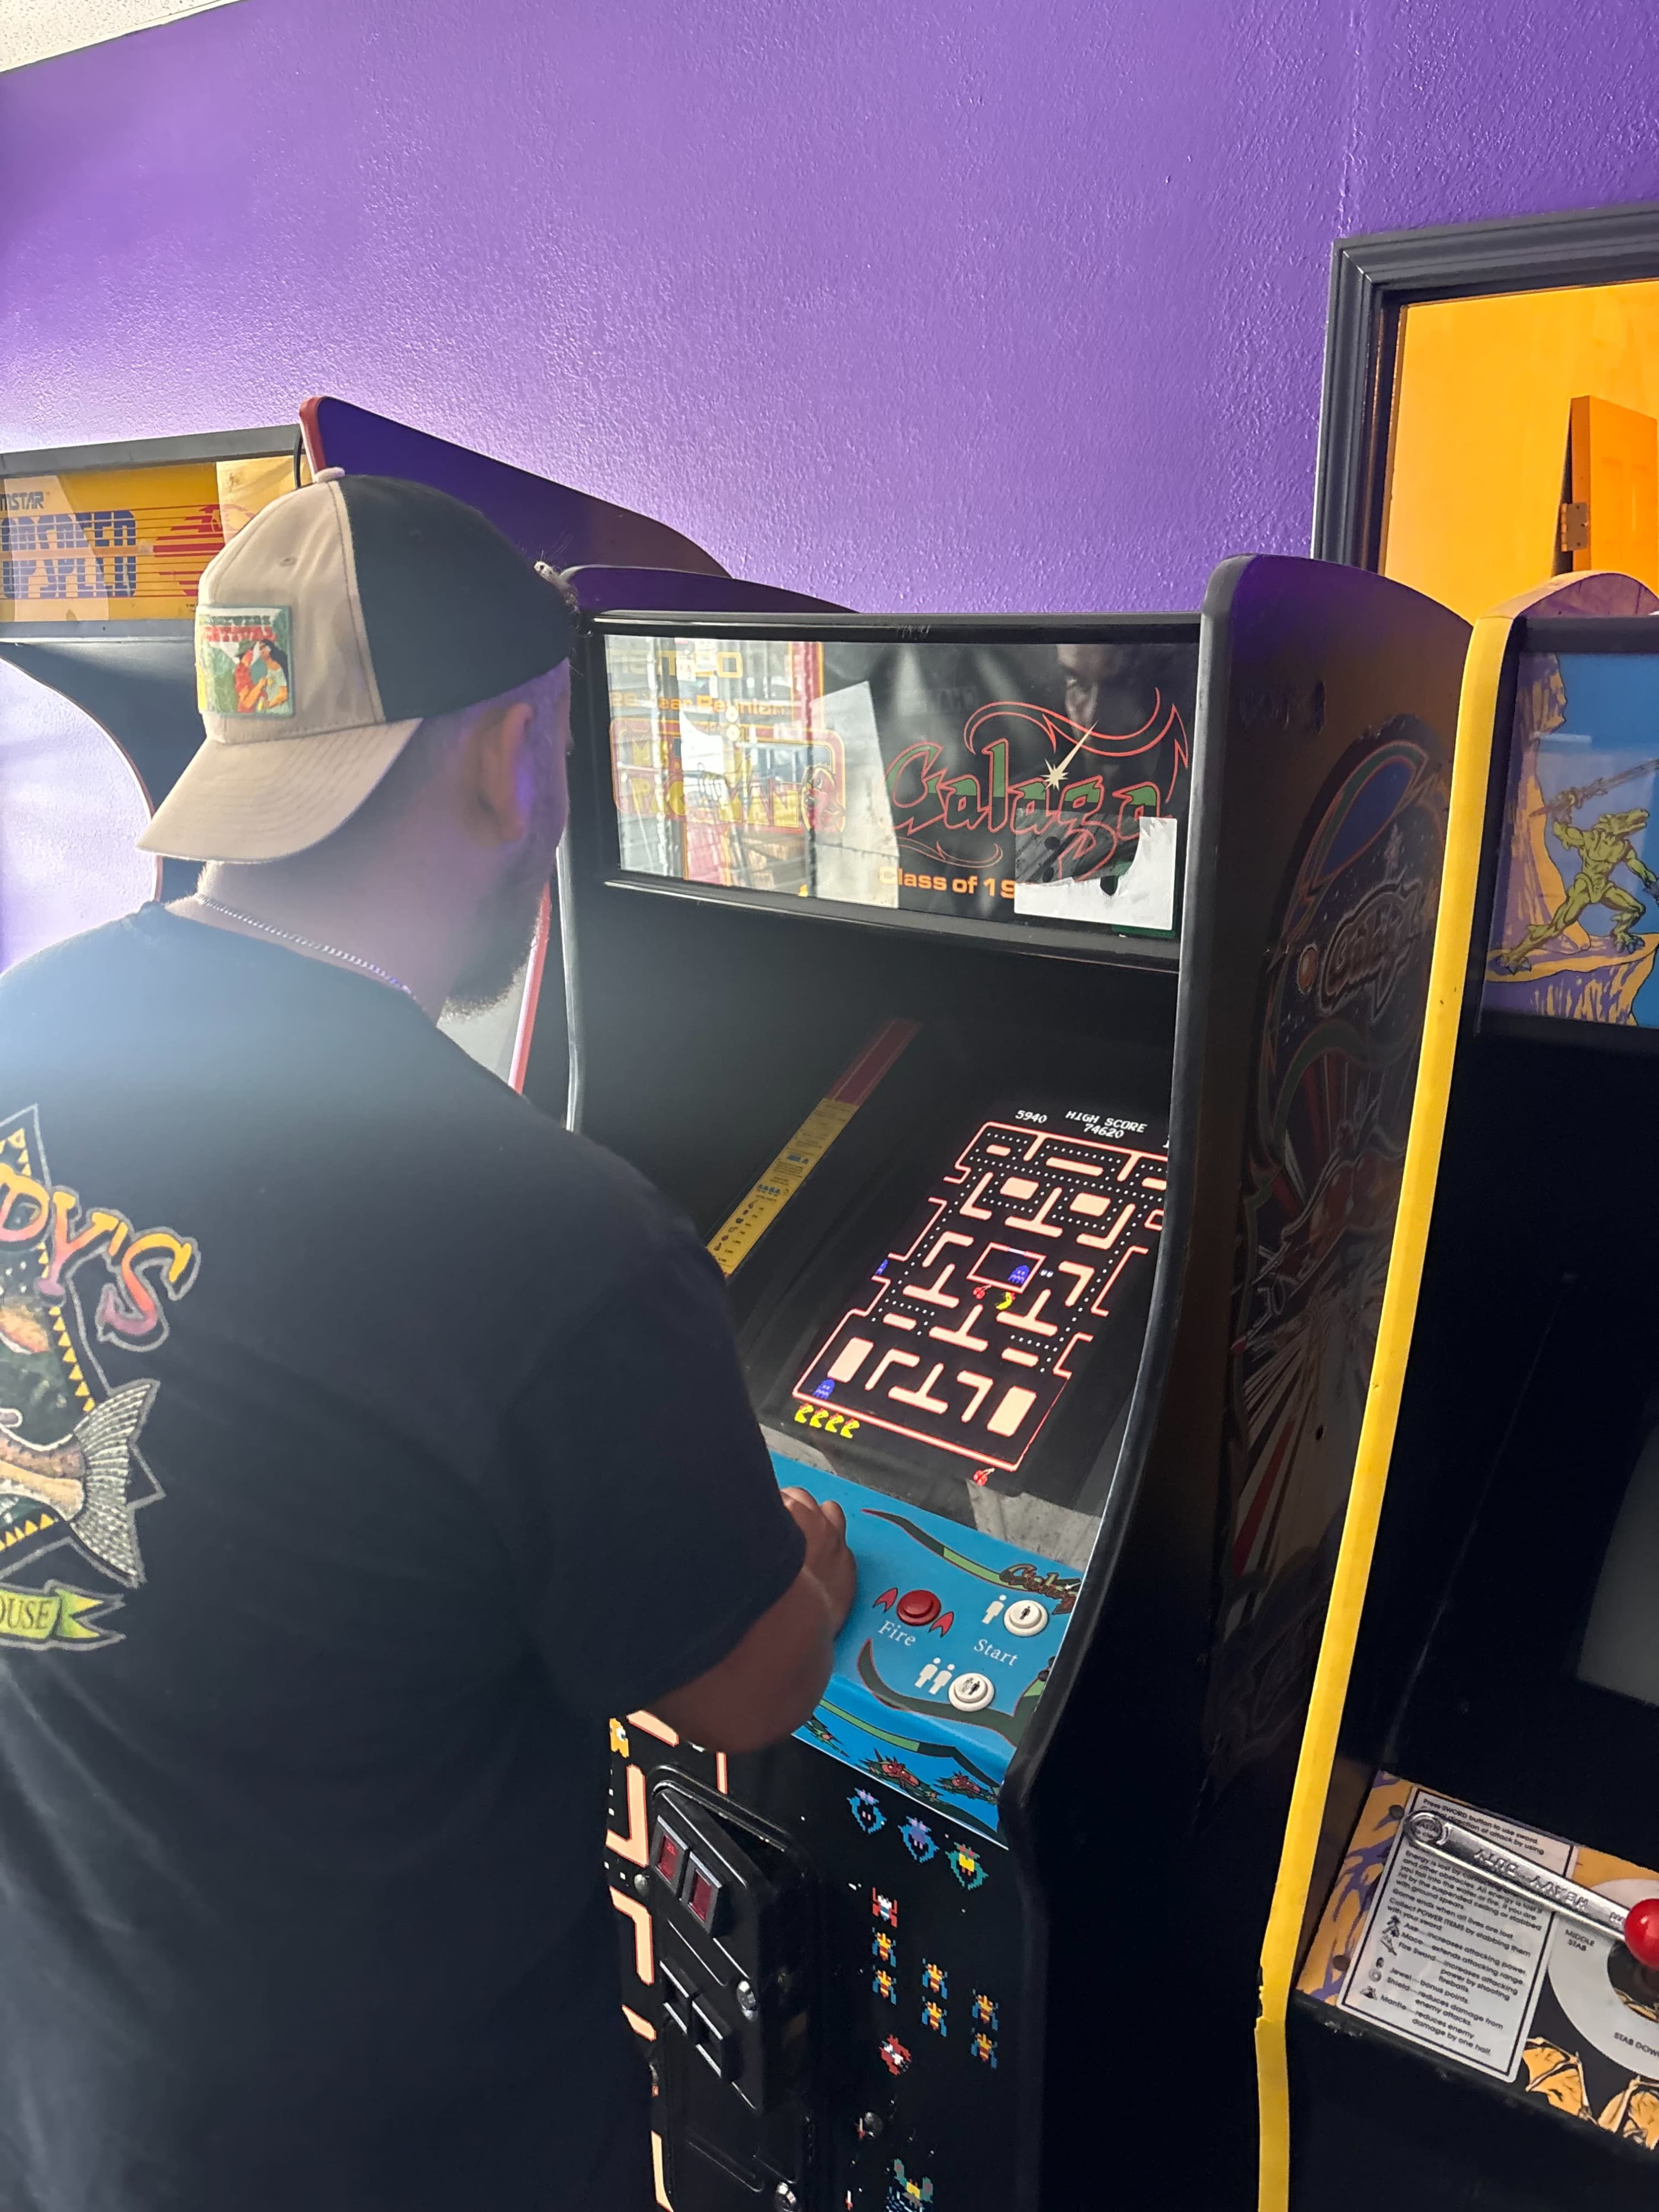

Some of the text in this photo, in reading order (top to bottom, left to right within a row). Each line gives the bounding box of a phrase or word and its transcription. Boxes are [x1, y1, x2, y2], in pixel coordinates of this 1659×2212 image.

[879, 865, 1015, 899] Class of 19
[1015, 1109, 1147, 1133] 5940 HIGH SCORE
[1083, 1123, 1124, 1138] 74620
[877, 1620, 916, 1646] Fire
[974, 1638, 1018, 1666] Start
[1423, 1798, 1440, 1809] Press
[1442, 1805, 1467, 1818] SWORD
[1468, 1815, 1492, 1827] button
[1489, 1831, 1512, 1843] attack
[1524, 1844, 1544, 1855] using
[1405, 1850, 1429, 1863] Energy
[1452, 1867, 1461, 1875] by
[1396, 1880, 1410, 1889] with
[1411, 1886, 1438, 1899] ground
[1400, 1865, 1414, 1873] you
[1414, 1870, 1426, 1878] fall
[1427, 1875, 1441, 1884] into
[1443, 1881, 1454, 1889] the
[1456, 1887, 1476, 1897] water
[1508, 1907, 1522, 1915] you
[1403, 1858, 1418, 1867] and
[1418, 1864, 1438, 1874] other
[1488, 1891, 1514, 1904] energy
[1523, 1902, 1537, 1911] lost
[1387, 1905, 1402, 1915] with
[1403, 1912, 1418, 1921] your
[1392, 1888, 1415, 1901] Game
[1416, 1898, 1434, 1908] ends
[1436, 1905, 1455, 1916] when
[1468, 1917, 1484, 1928] lives
[1485, 1925, 1498, 1933] are
[1408, 1875, 1417, 1884] by
[1418, 1879, 1430, 1888] the
[1432, 1885, 1472, 1904] suspended
[1474, 1902, 1499, 1916] ceiling
[1509, 1915, 1541, 1931] stabbed
[1389, 1897, 1416, 1911] Collect
[1417, 1908, 1443, 1922] POWER
[1444, 1919, 1464, 1931] ITEMS
[1476, 1932, 1510, 1950] stabbing
[1511, 1945, 1530, 1957] them
[1564, 1929, 1595, 1947] MIDDLE
[1464, 1947, 1500, 1966] attacking
[1567, 1939, 1587, 1951] STAB
[1398, 1942, 1411, 1951] Fire
[1481, 1977, 1518, 1995] attacking
[1462, 1958, 1498, 1976] attacking
[1440, 1969, 1510, 2001] power by shooting
[1415, 1999, 1441, 2013] enemy
[1450, 2005, 1484, 2021] damage
[1485, 2018, 1503, 2029] from
[1412, 2018, 1445, 2035] damage
[1447, 2032, 1457, 2041] by
[1458, 2038, 1473, 2047] one
[1447, 2024, 1474, 2039] enemy
[1614, 2032, 1634, 2046] STAB
